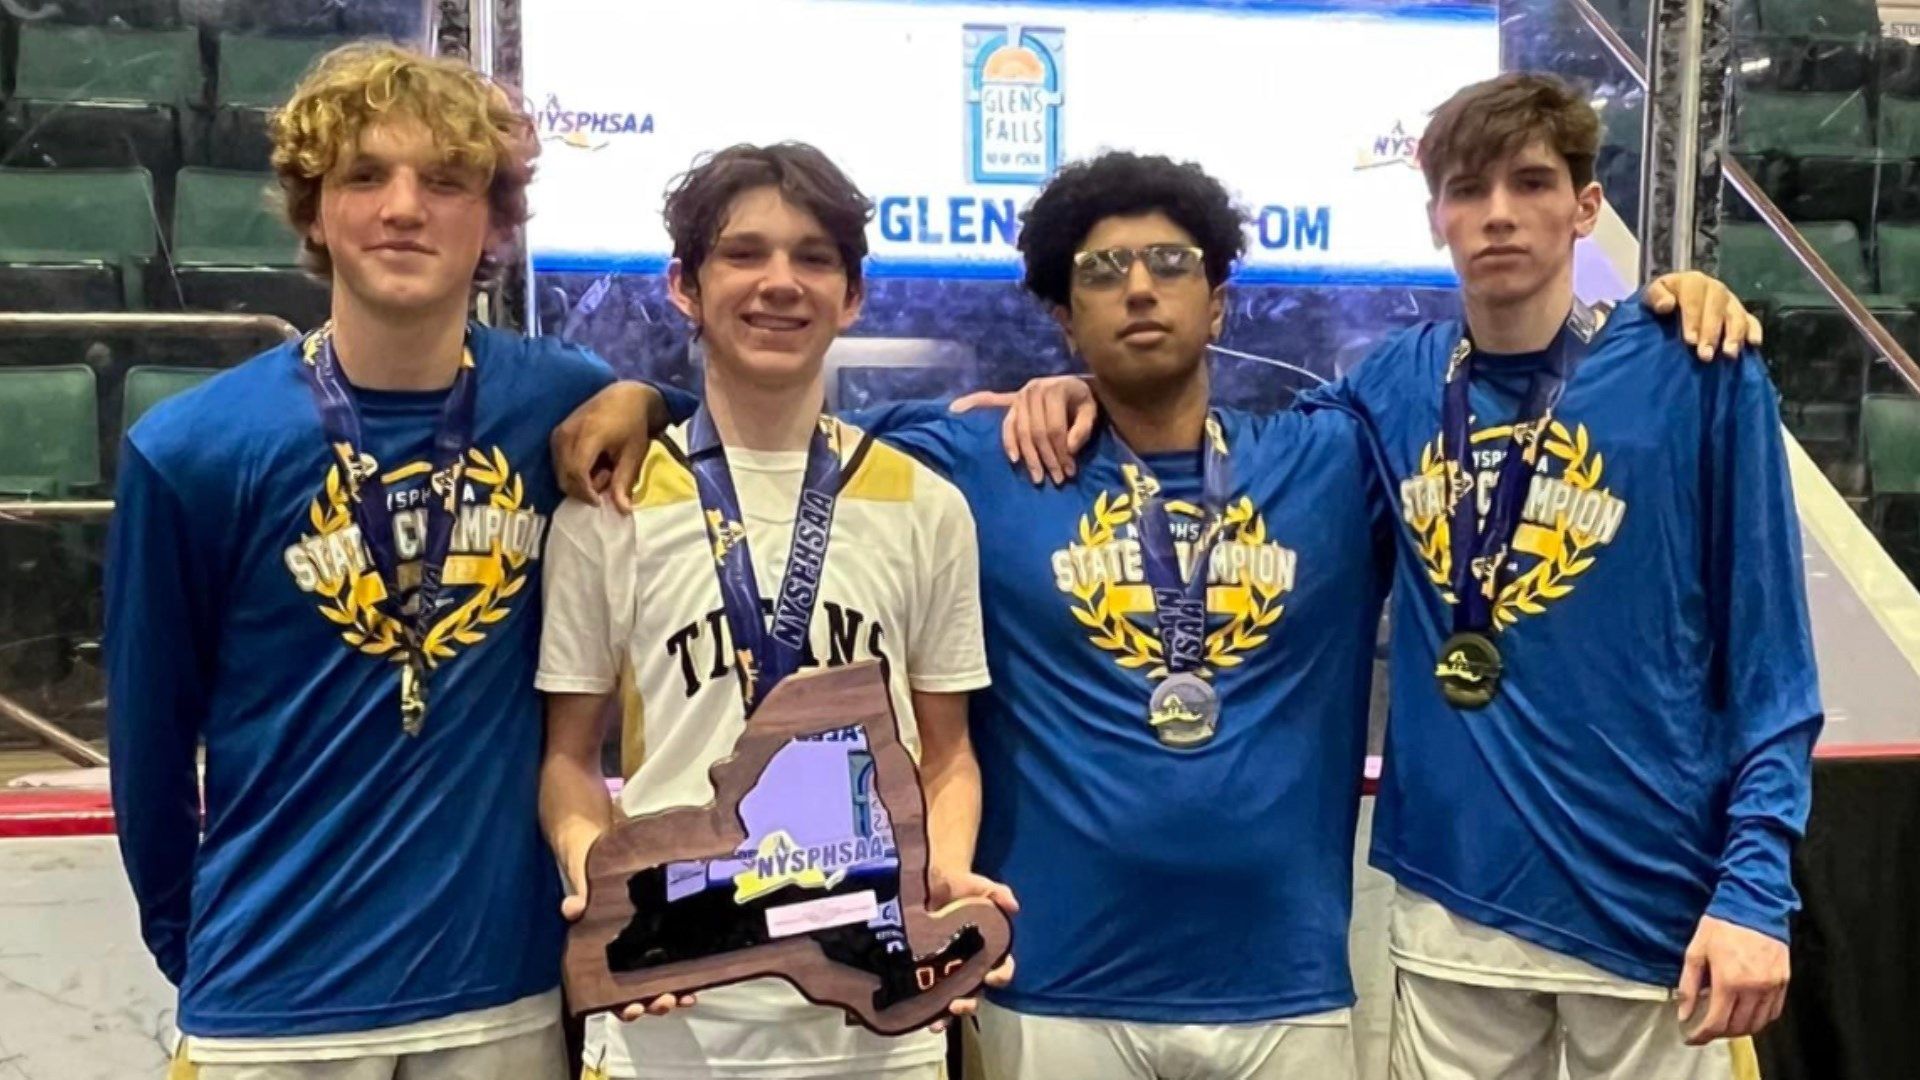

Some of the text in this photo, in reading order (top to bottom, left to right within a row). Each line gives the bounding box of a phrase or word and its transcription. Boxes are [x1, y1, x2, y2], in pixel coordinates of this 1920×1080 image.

[984, 89, 1043, 114] GLENS
[985, 118, 1043, 144] FALLS
[880, 196, 1017, 245] GLEN
[284, 522, 377, 593] STAT
[768, 488, 834, 650] NYSPHSAA
[1051, 540, 1145, 593] STATE
[757, 837, 883, 880] NYSPHSAA
